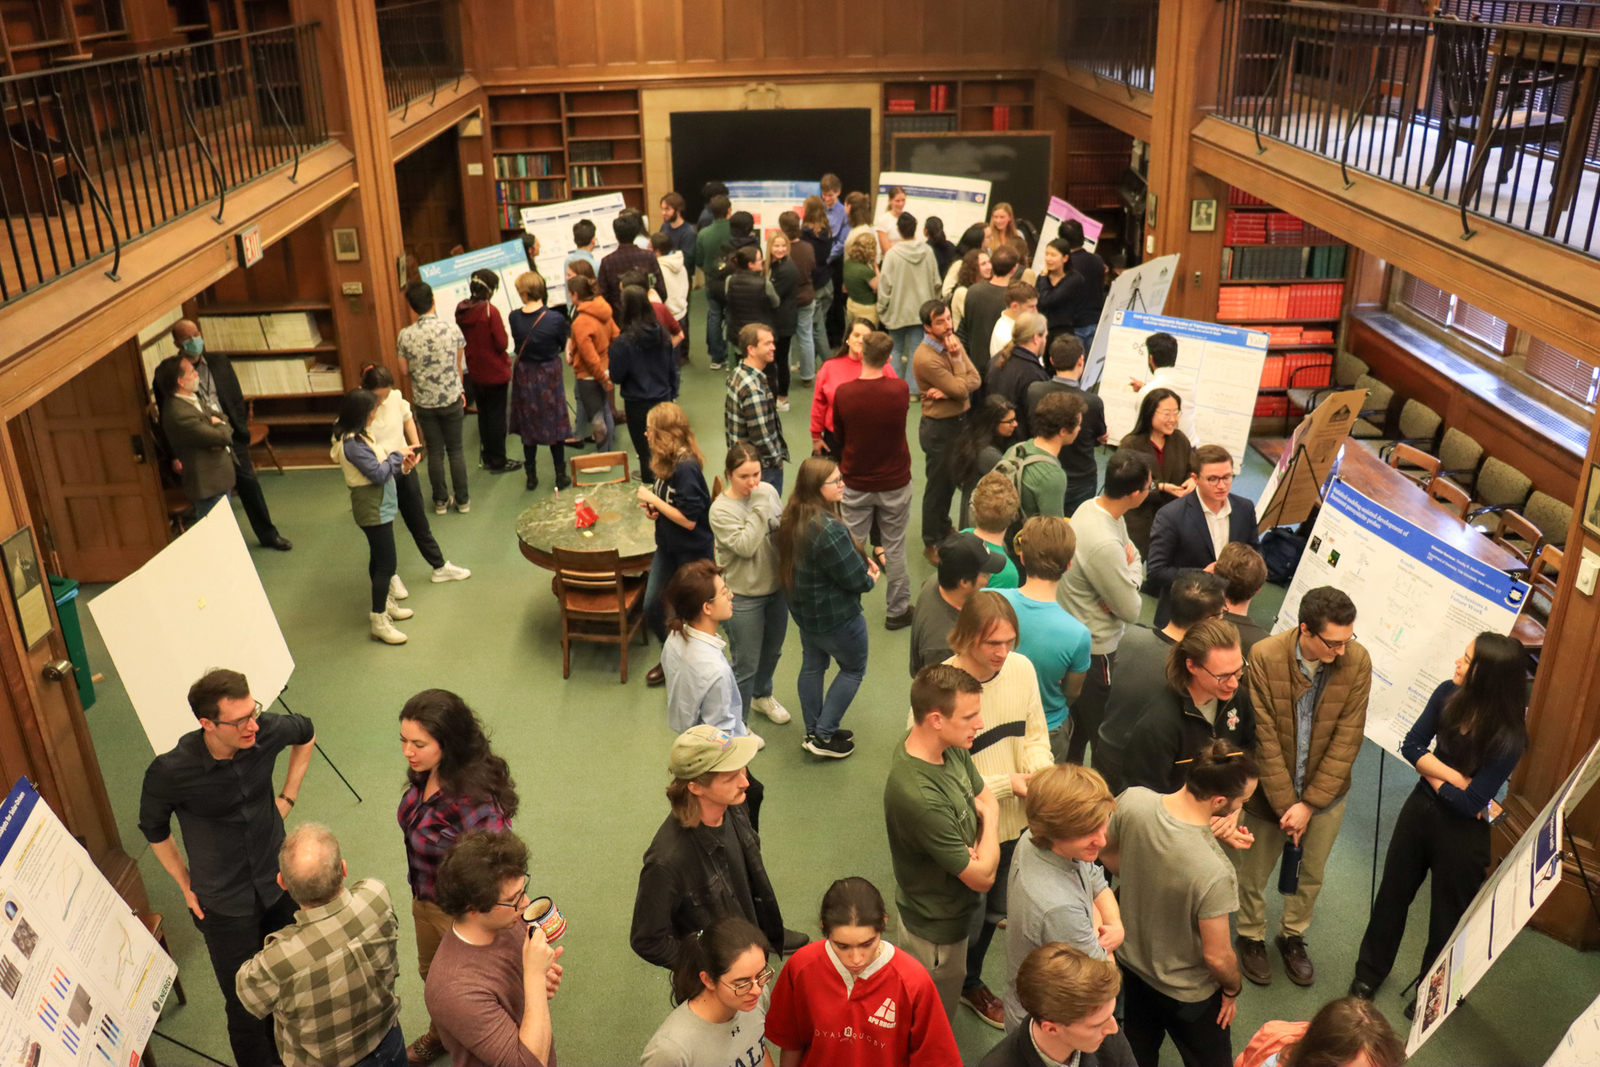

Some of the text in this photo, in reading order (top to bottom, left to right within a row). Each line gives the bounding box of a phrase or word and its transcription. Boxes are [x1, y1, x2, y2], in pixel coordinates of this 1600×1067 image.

[243, 230, 261, 263] EXIT
[422, 265, 441, 278] Yale
[1450, 594, 1482, 615] Future Work
[1452, 589, 1484, 609] Conclusions
[157, 974, 173, 1004] ENERGY
[867, 1015, 897, 1029] APU RUGBY
[814, 1029, 842, 1039] OYAL
